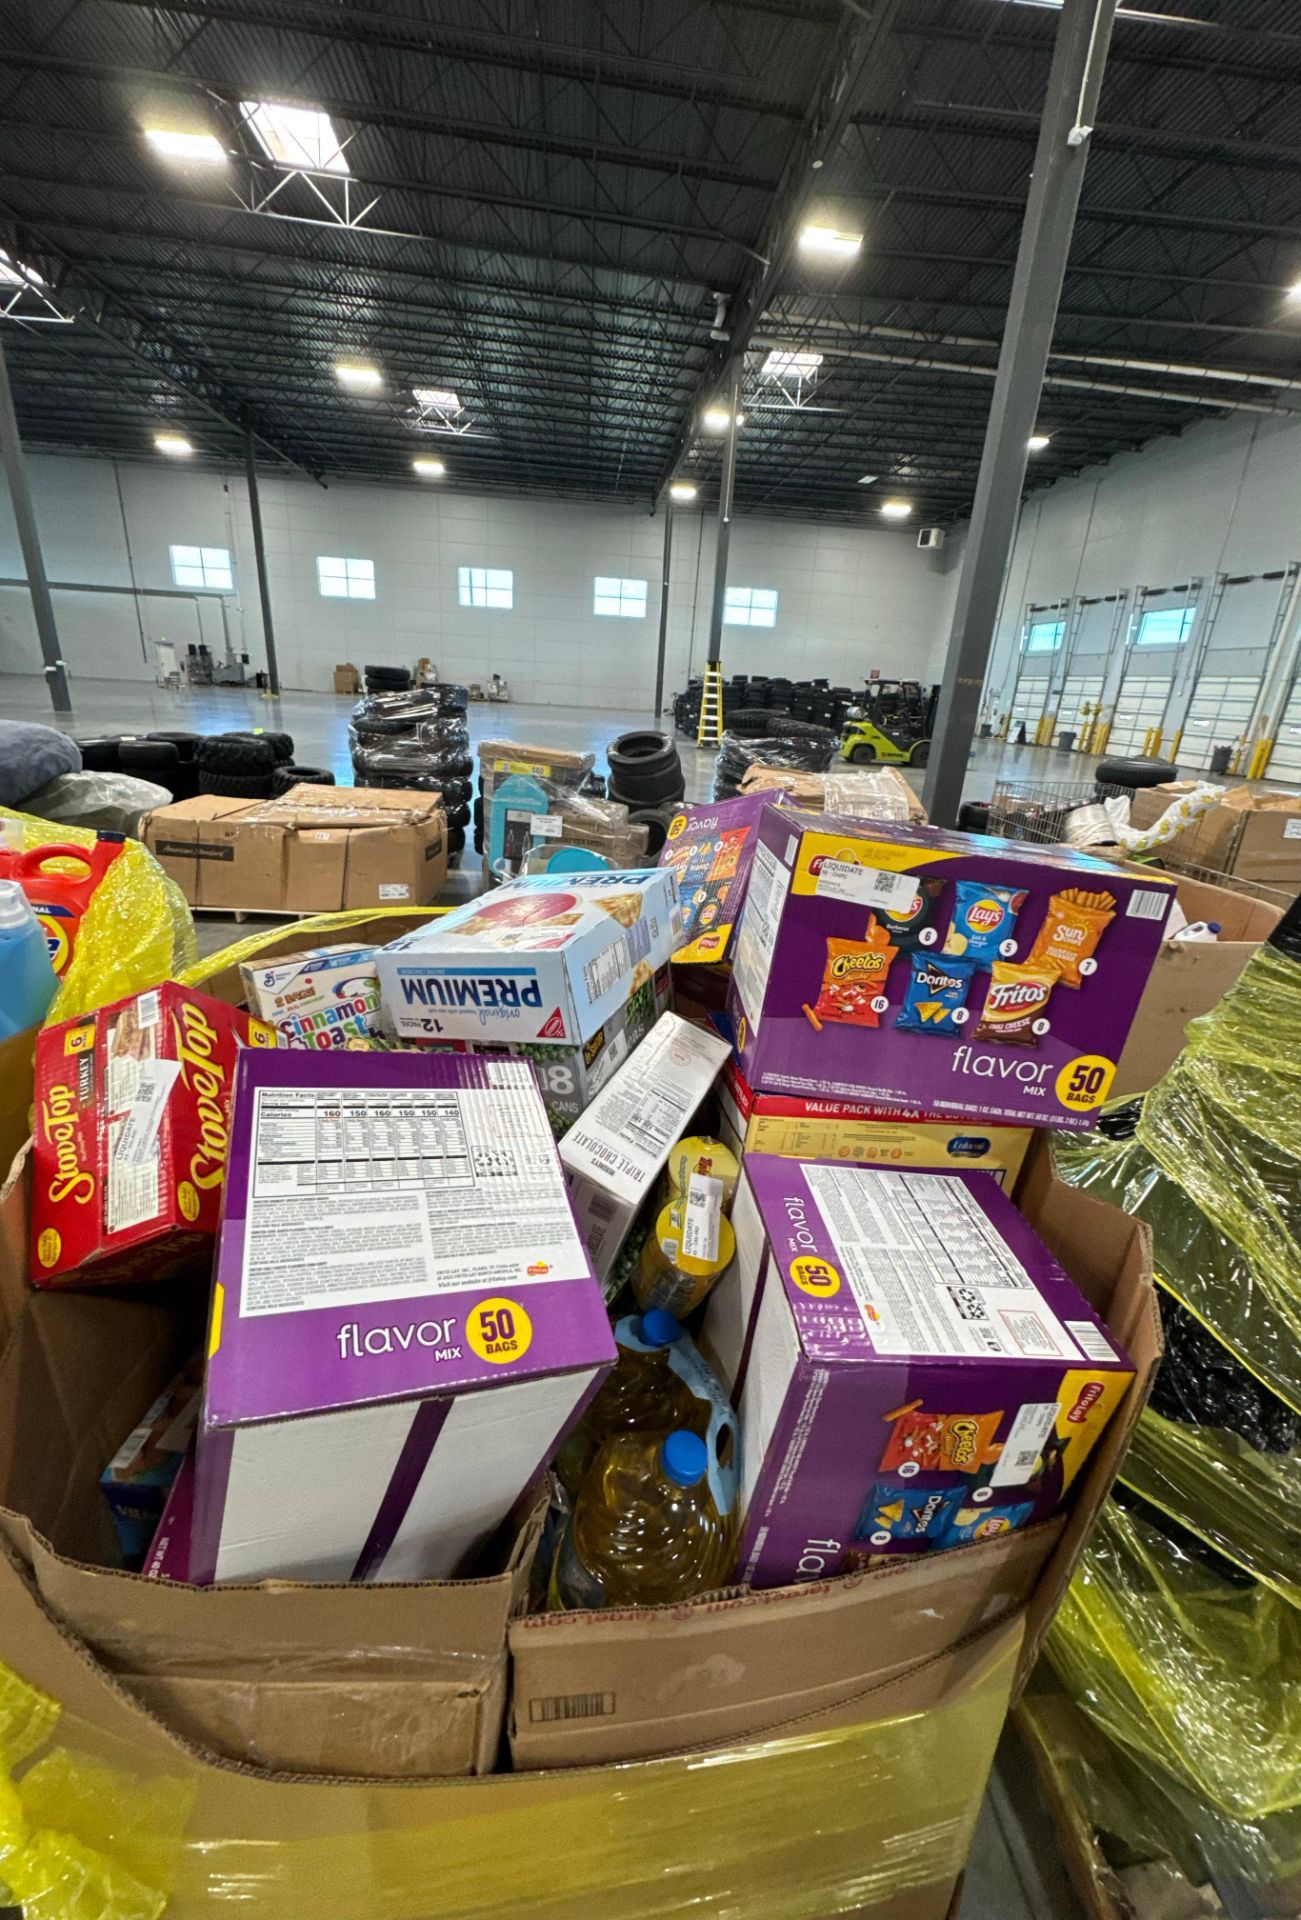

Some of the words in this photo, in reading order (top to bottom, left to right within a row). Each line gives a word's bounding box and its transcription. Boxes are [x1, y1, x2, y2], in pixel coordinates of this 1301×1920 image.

[687, 816, 718, 832] flavor
[823, 861, 863, 876] LIQUIDATE
[924, 931, 931, 941] 6
[1053, 924, 1086, 942] Sun
[1005, 943, 1011, 953] 5
[832, 953, 884, 978] Cheetos
[1085, 961, 1092, 971] 7
[916, 972, 963, 989] Doritos
[400, 978, 543, 1008] PREMIUM
[875, 1000, 884, 1009] 16
[989, 982, 1047, 1010] Fritos
[278, 993, 379, 1040] Cinnamon
[420, 1018, 444, 1032] 12
[71, 1036, 83, 1048] 6
[254, 1031, 265, 1043] 6
[303, 1015, 369, 1050] Toast
[79, 1056, 89, 1101] TURKEY
[951, 1045, 1053, 1083] flavor
[1069, 1065, 1106, 1094] 50
[1023, 1085, 1047, 1096] MIX
[1066, 1092, 1096, 1104] BAGS
[552, 1100, 579, 1113] CANS
[805, 1102, 840, 1114] VALUE
[842, 1104, 871, 1115] PACK
[873, 1106, 902, 1116] WITH
[116, 1117, 136, 1161] LIQUIDATE
[571, 1131, 618, 1164] CHOCOLATE
[618, 1158, 647, 1183] TRIPLE
[685, 1218, 695, 1254] LIQUIDATE
[783, 1197, 818, 1252] flavor
[805, 1264, 832, 1287] 50
[787, 1237, 799, 1252] MIX
[796, 1264, 809, 1286] BAGS
[336, 1318, 456, 1359] flavor
[480, 1308, 516, 1342] 50
[434, 1347, 462, 1361] MIX
[486, 1340, 518, 1354] BAGS
[951, 1420, 978, 1464] Cheetos
[902, 1465, 915, 1474] 16
[915, 1495, 942, 1534] Doritos
